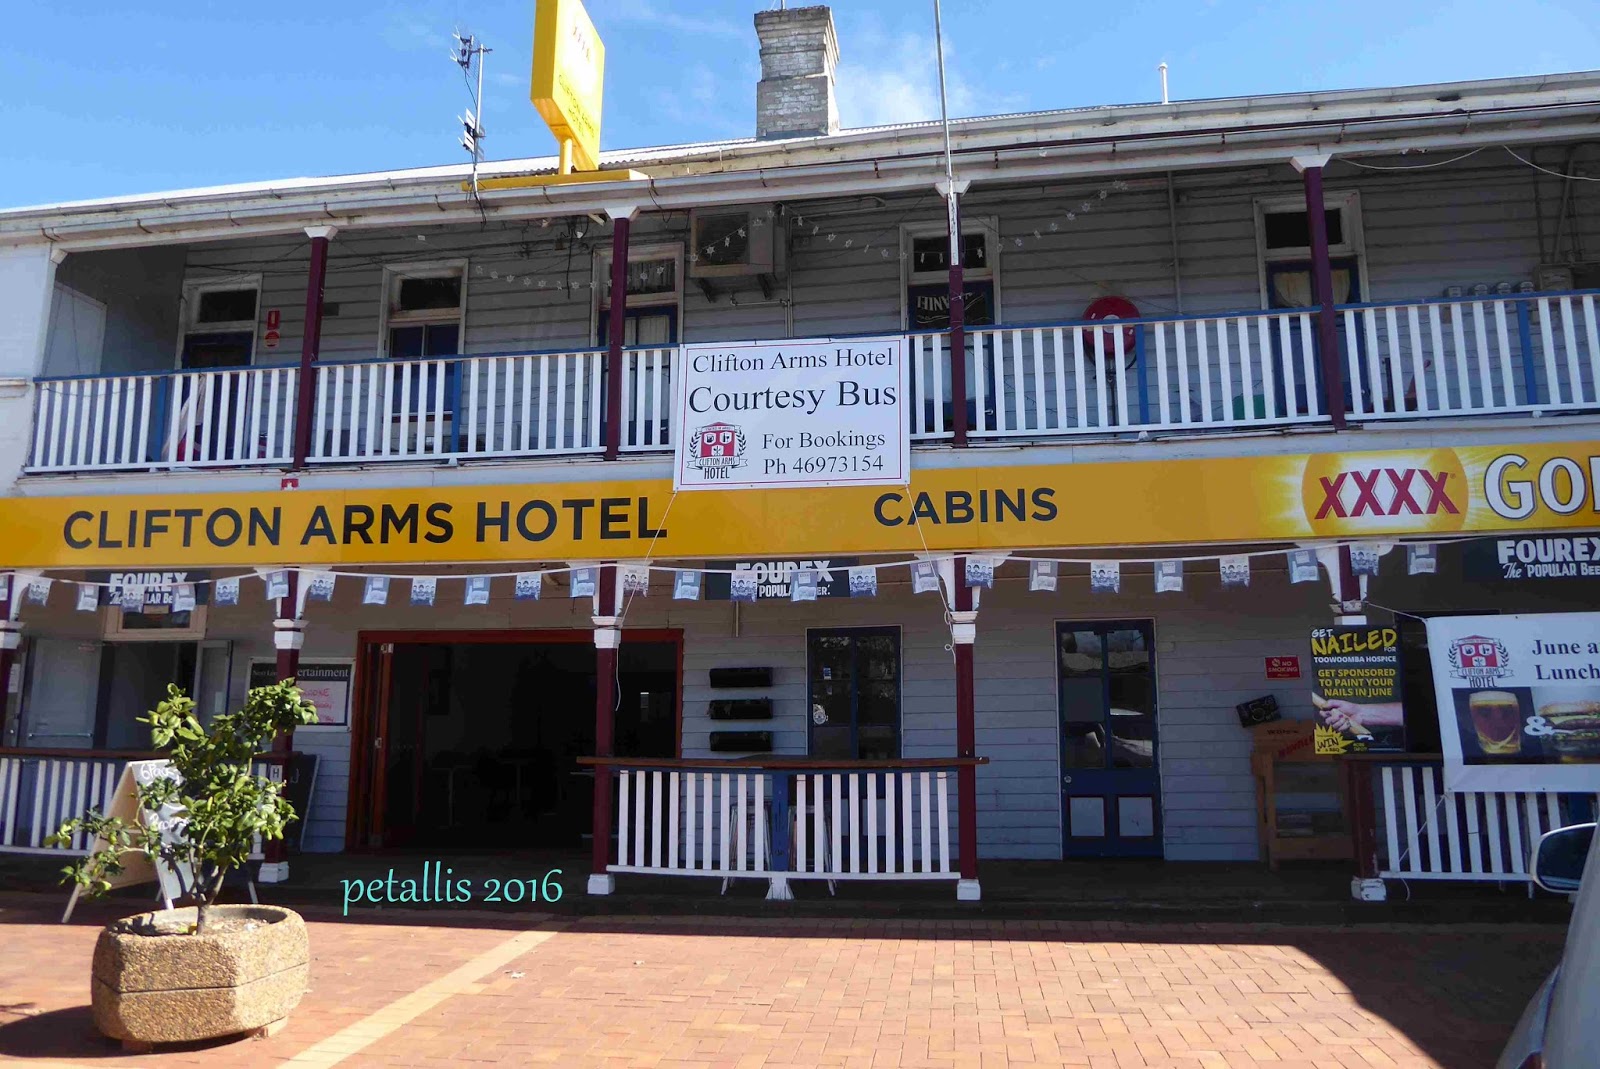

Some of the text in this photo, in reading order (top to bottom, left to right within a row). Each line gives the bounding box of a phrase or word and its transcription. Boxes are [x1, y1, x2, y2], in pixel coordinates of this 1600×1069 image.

[693, 347, 893, 373] Clifton Arms Hotel
[689, 380, 896, 415] Courtesy Bus
[762, 430, 886, 450] For Bookings
[699, 458, 720, 466] CLIFTON
[764, 455, 883, 474] Ph 46973154
[704, 467, 730, 479] HOTEL
[1314, 468, 1460, 519] XXXX
[873, 487, 1058, 527] CABINS
[64, 497, 667, 549] CLIFTON ARMS HOTEL
[1502, 562, 1522, 579] The
[1311, 628, 1333, 638] GET
[1311, 628, 1397, 656] NAILED
[1532, 639, 1581, 655] June
[297, 666, 349, 677] ertainment
[1318, 668, 1396, 677] GET SPONSORED
[1319, 678, 1394, 687] TO PAINT YOUR
[1469, 676, 1497, 688] HOTEL
[1324, 687, 1392, 698] NAILS IN JUNE
[1317, 737, 1339, 749] WIN
